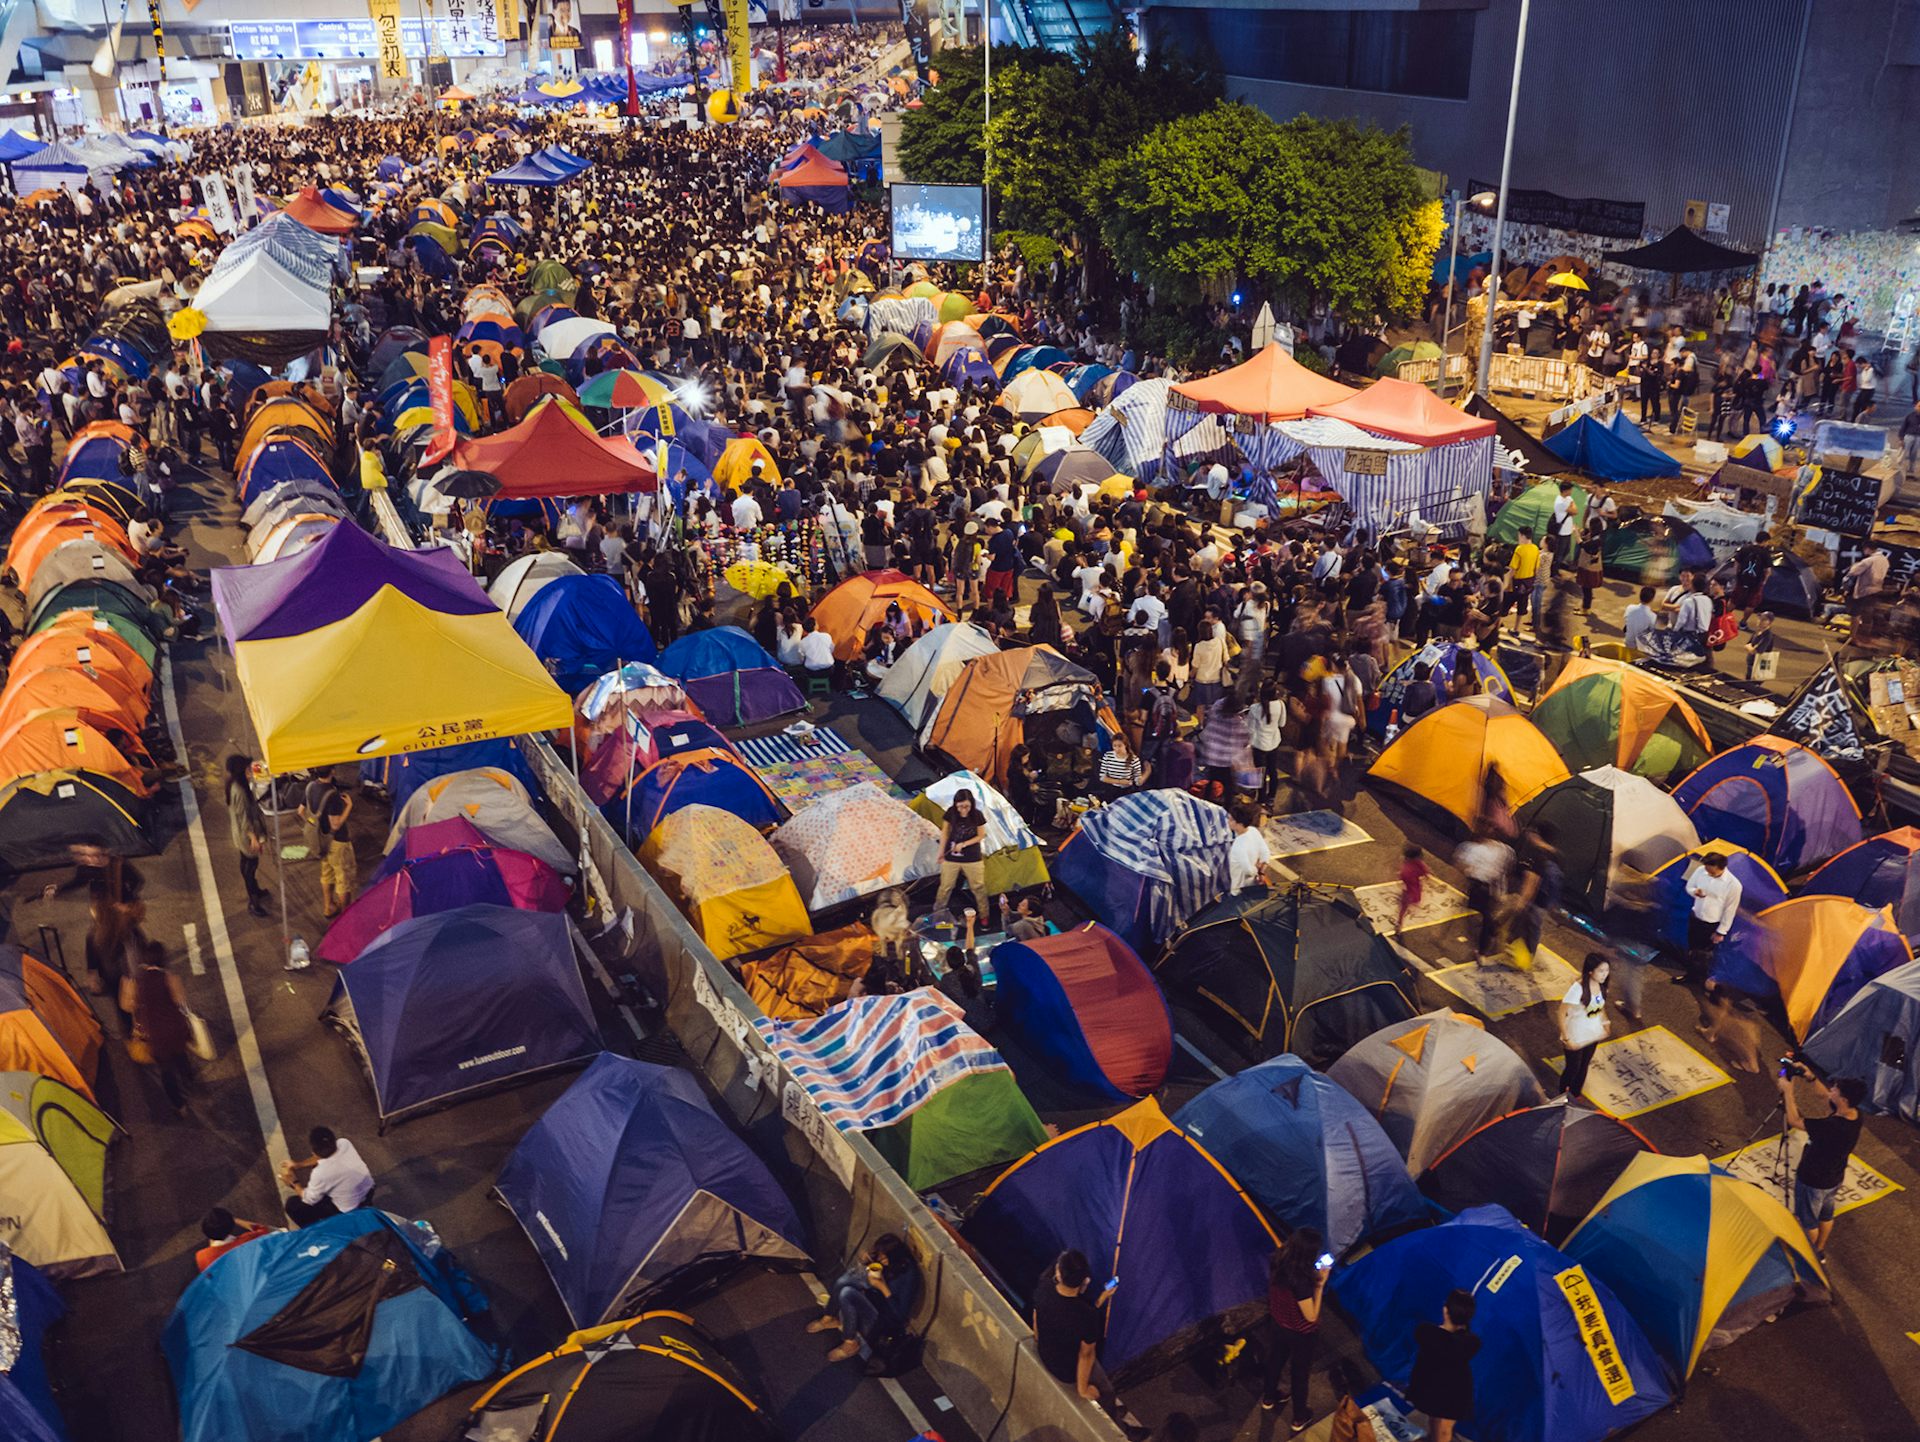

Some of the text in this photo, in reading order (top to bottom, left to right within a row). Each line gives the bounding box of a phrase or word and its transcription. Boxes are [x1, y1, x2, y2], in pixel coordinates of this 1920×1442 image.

[233, 25, 293, 33] Cotton Tree Drive
[417, 718, 484, 739] 公民黨
[402, 730, 500, 752] CIVIC PARTY
[1575, 1294, 1624, 1386] 我要真普選
